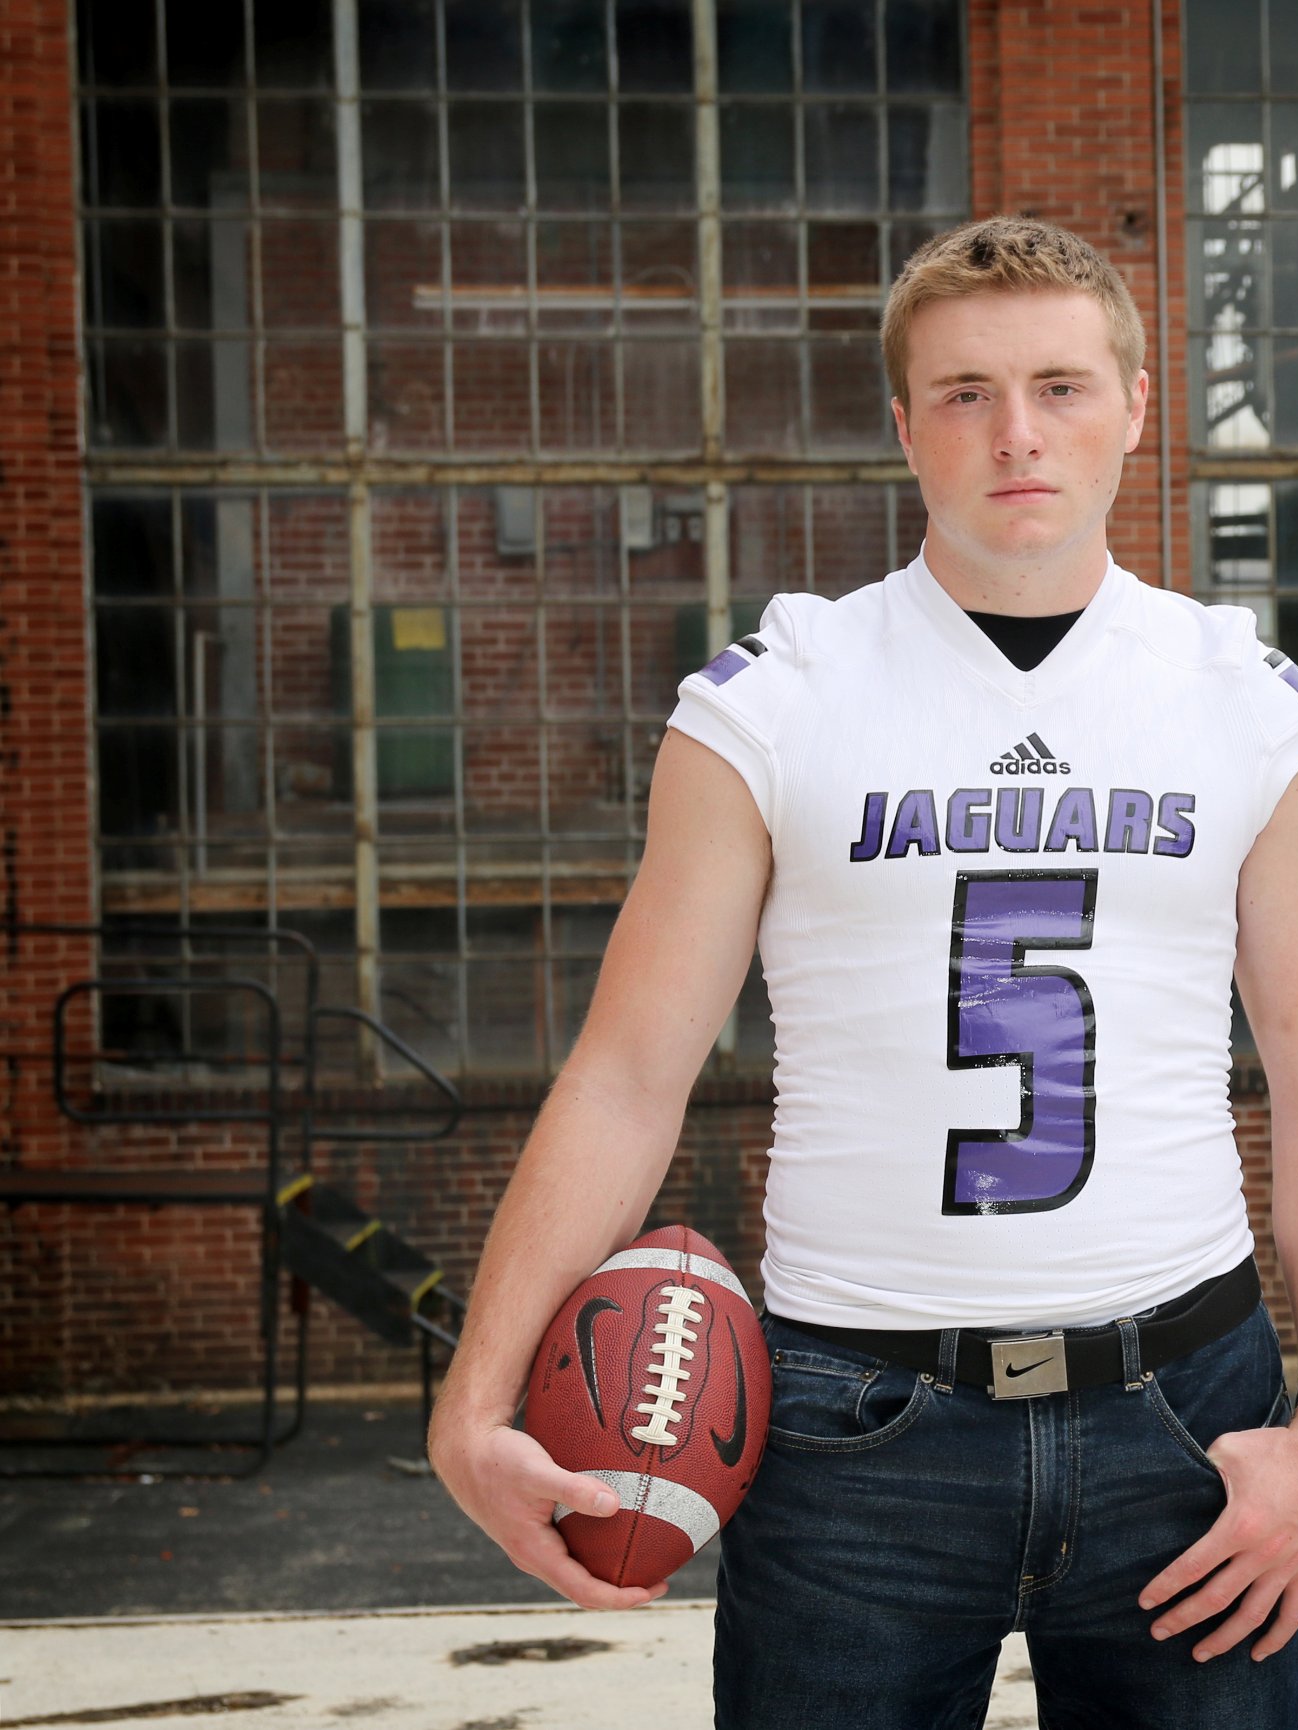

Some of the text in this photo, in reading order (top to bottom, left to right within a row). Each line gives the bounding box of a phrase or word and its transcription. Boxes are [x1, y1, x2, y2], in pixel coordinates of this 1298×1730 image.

[989, 757, 1072, 775] adidas
[850, 787, 1196, 863] JAGUARS
[941, 867, 1099, 1216] 5
